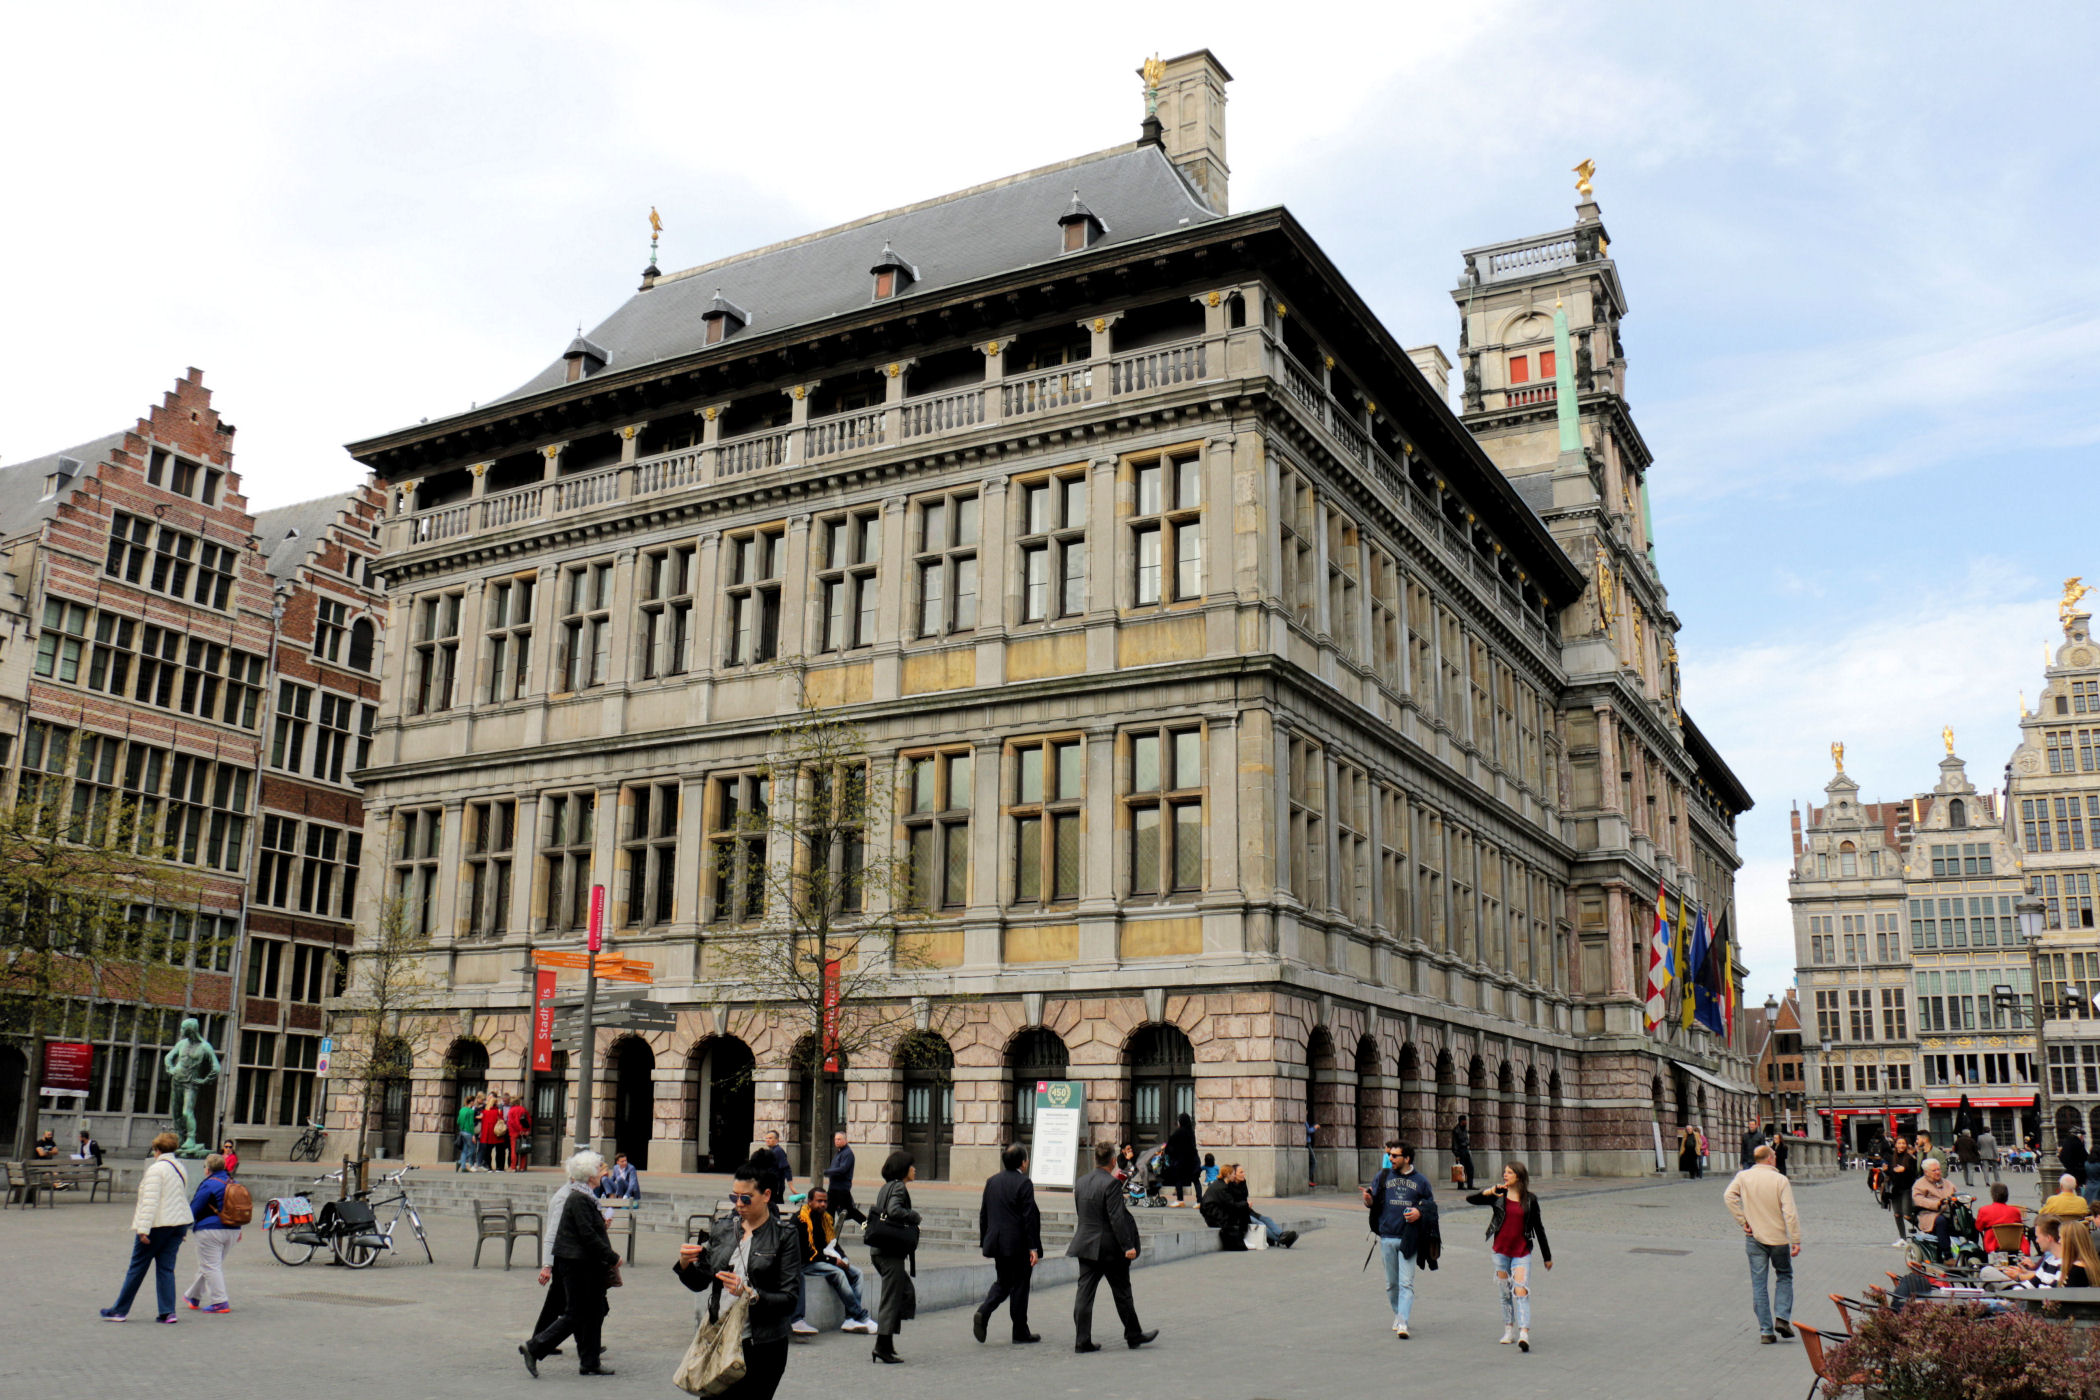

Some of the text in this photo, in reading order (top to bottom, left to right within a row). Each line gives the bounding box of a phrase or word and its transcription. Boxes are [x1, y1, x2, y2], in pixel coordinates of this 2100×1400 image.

[538, 988, 551, 1063] A Stadhis
[1051, 1088, 1066, 1097] 450
